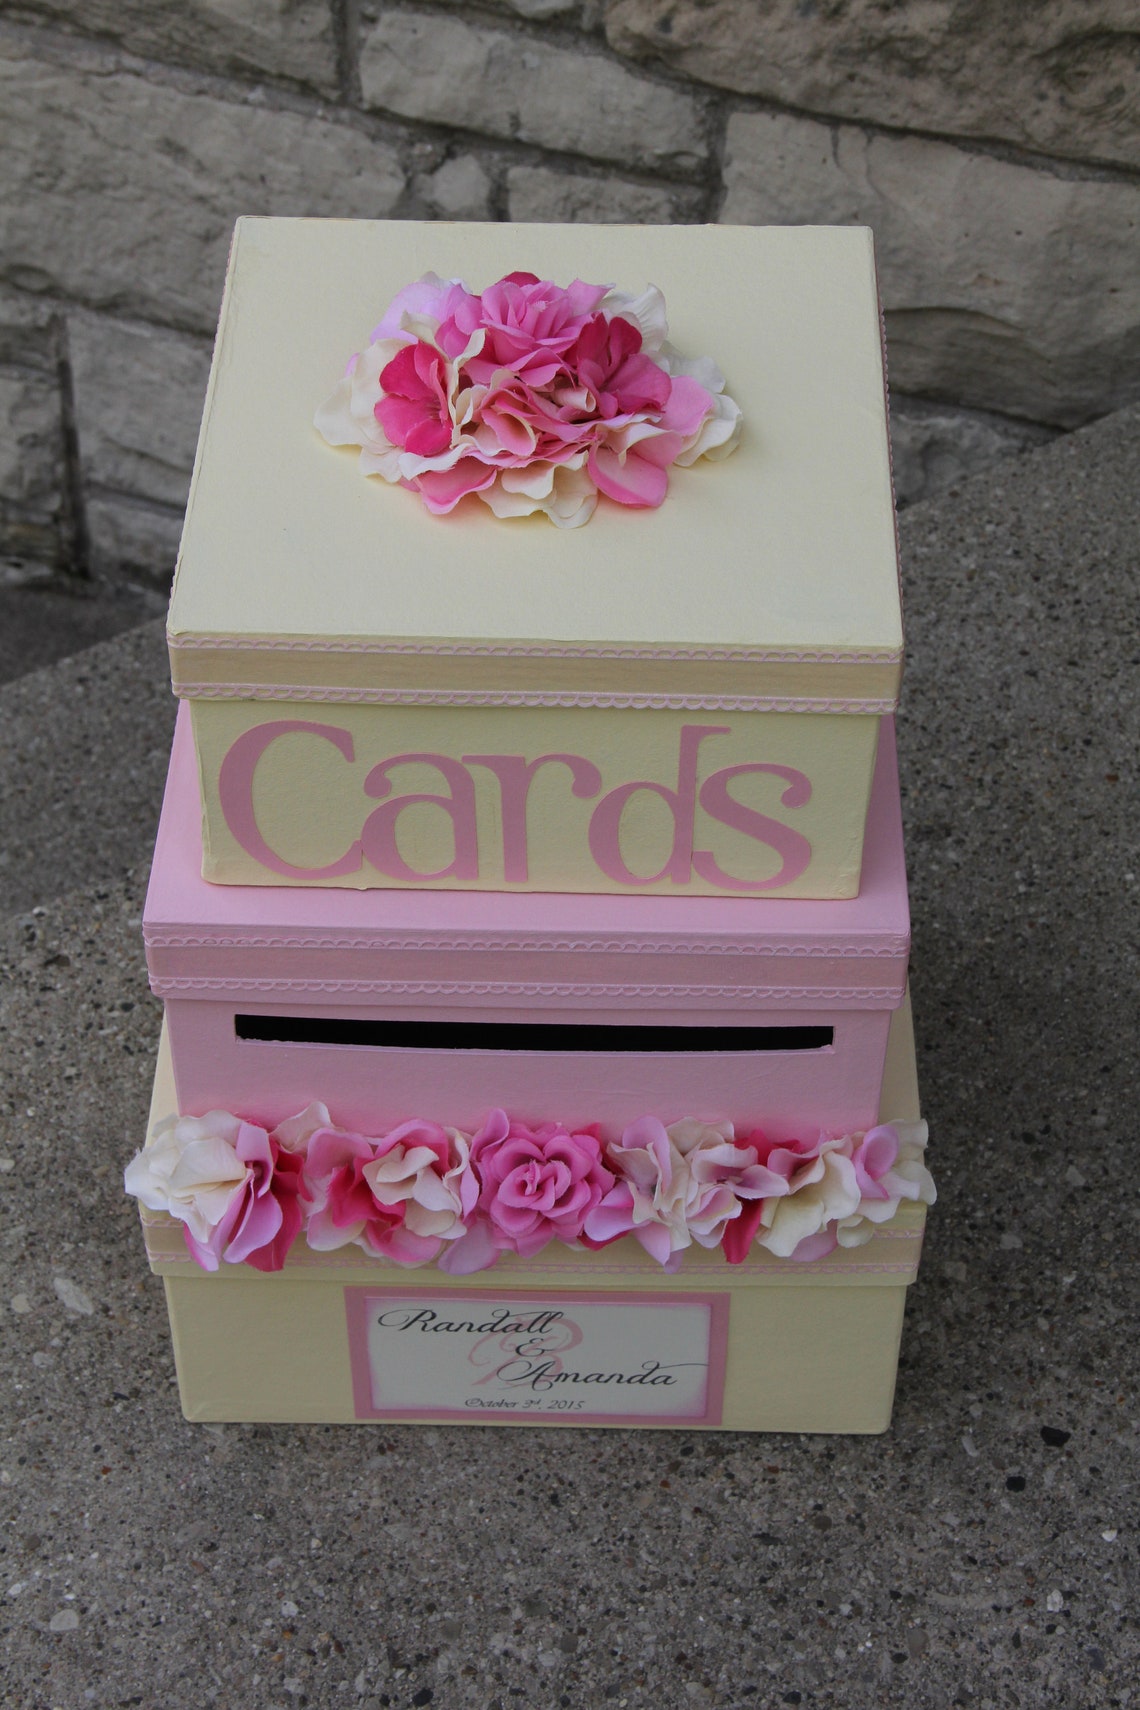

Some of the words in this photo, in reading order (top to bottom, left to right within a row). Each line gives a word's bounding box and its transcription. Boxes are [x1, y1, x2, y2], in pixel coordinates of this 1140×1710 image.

[218, 719, 812, 892] Cards
[377, 1308, 564, 1334] Randall
[515, 1337, 556, 1358] &
[496, 1359, 710, 1392] Amanda
[464, 1397, 519, 1409] October
[547, 1400, 586, 1410] 2015
